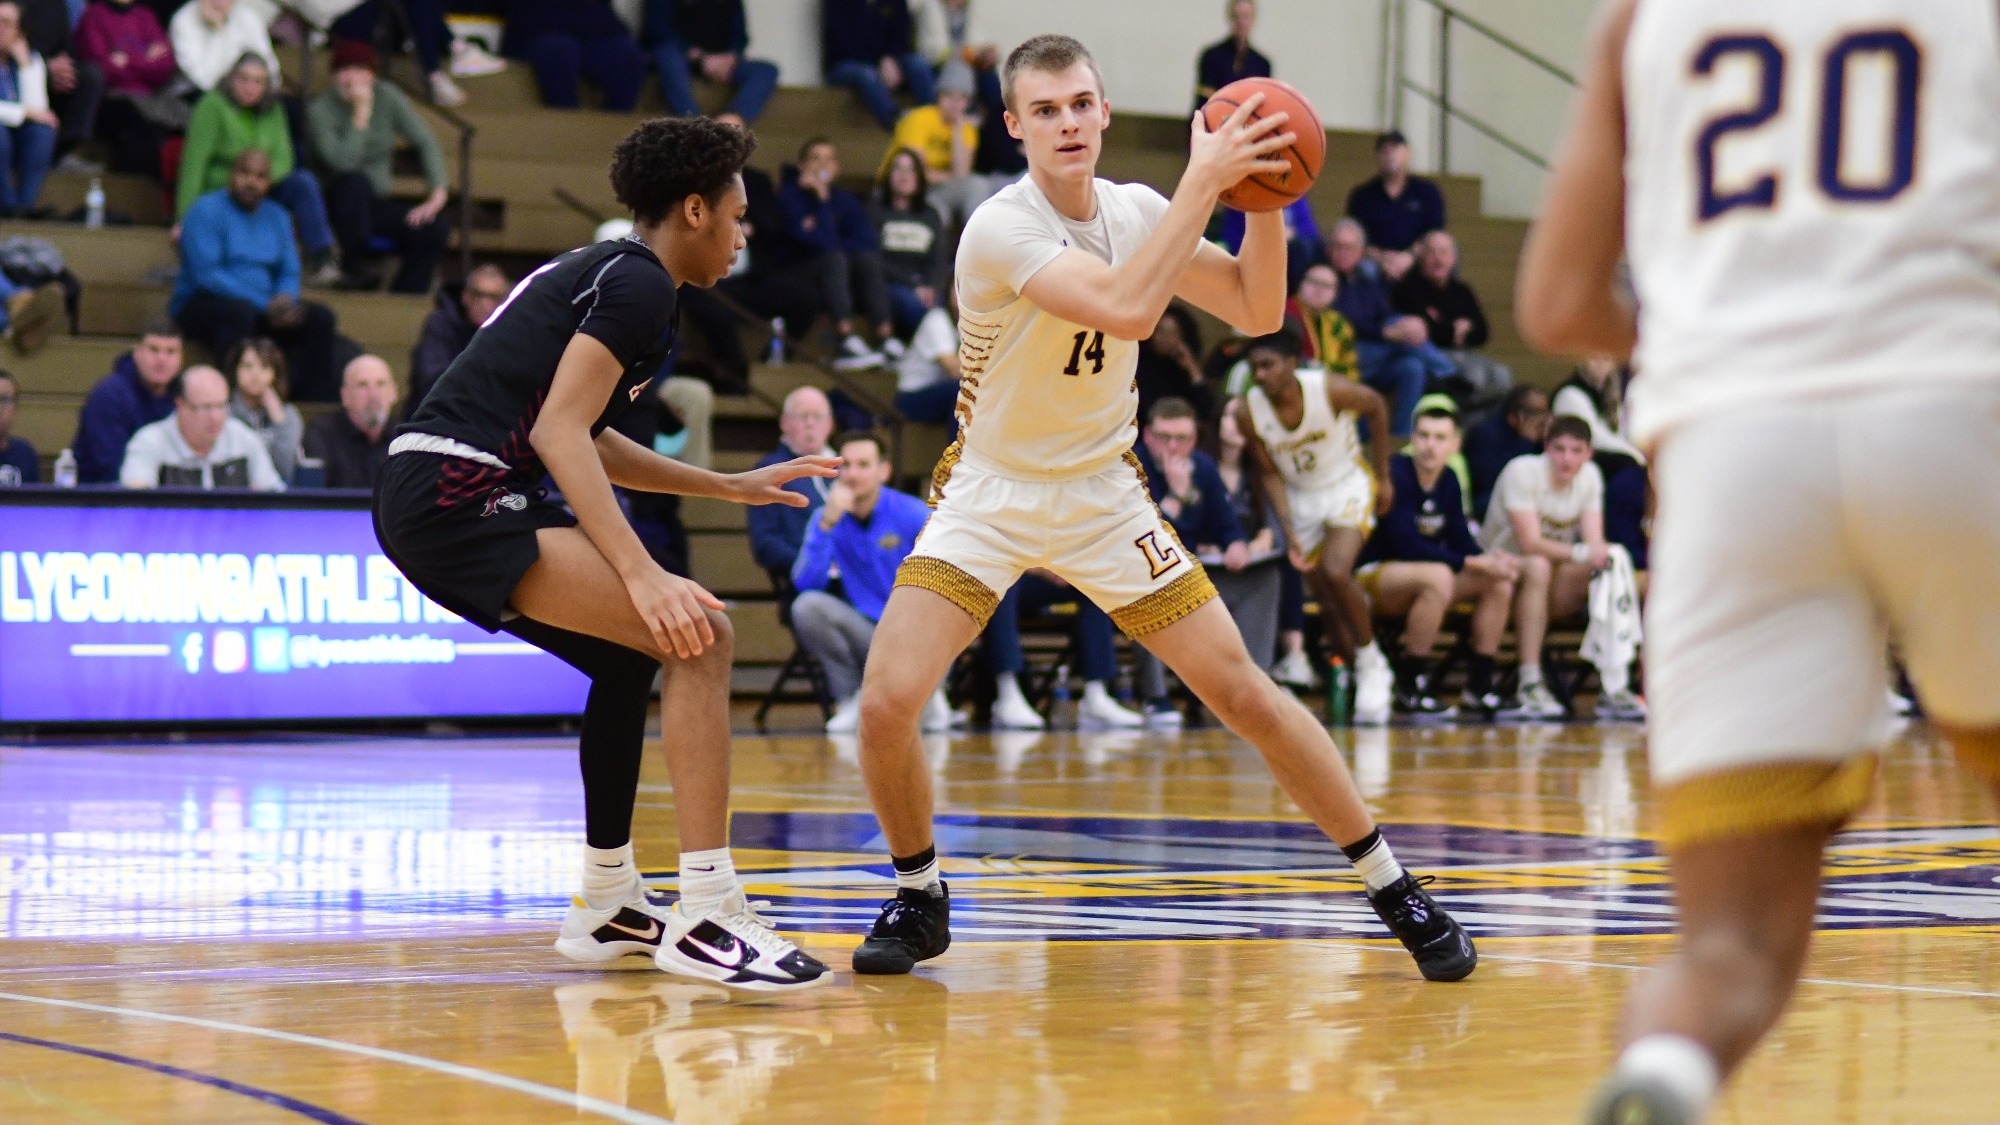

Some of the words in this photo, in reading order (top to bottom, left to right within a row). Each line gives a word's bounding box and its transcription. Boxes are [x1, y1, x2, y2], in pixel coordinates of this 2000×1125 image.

[1688, 26, 1923, 226] 20
[1063, 330, 1105, 376] 14
[1134, 529, 1182, 581] L
